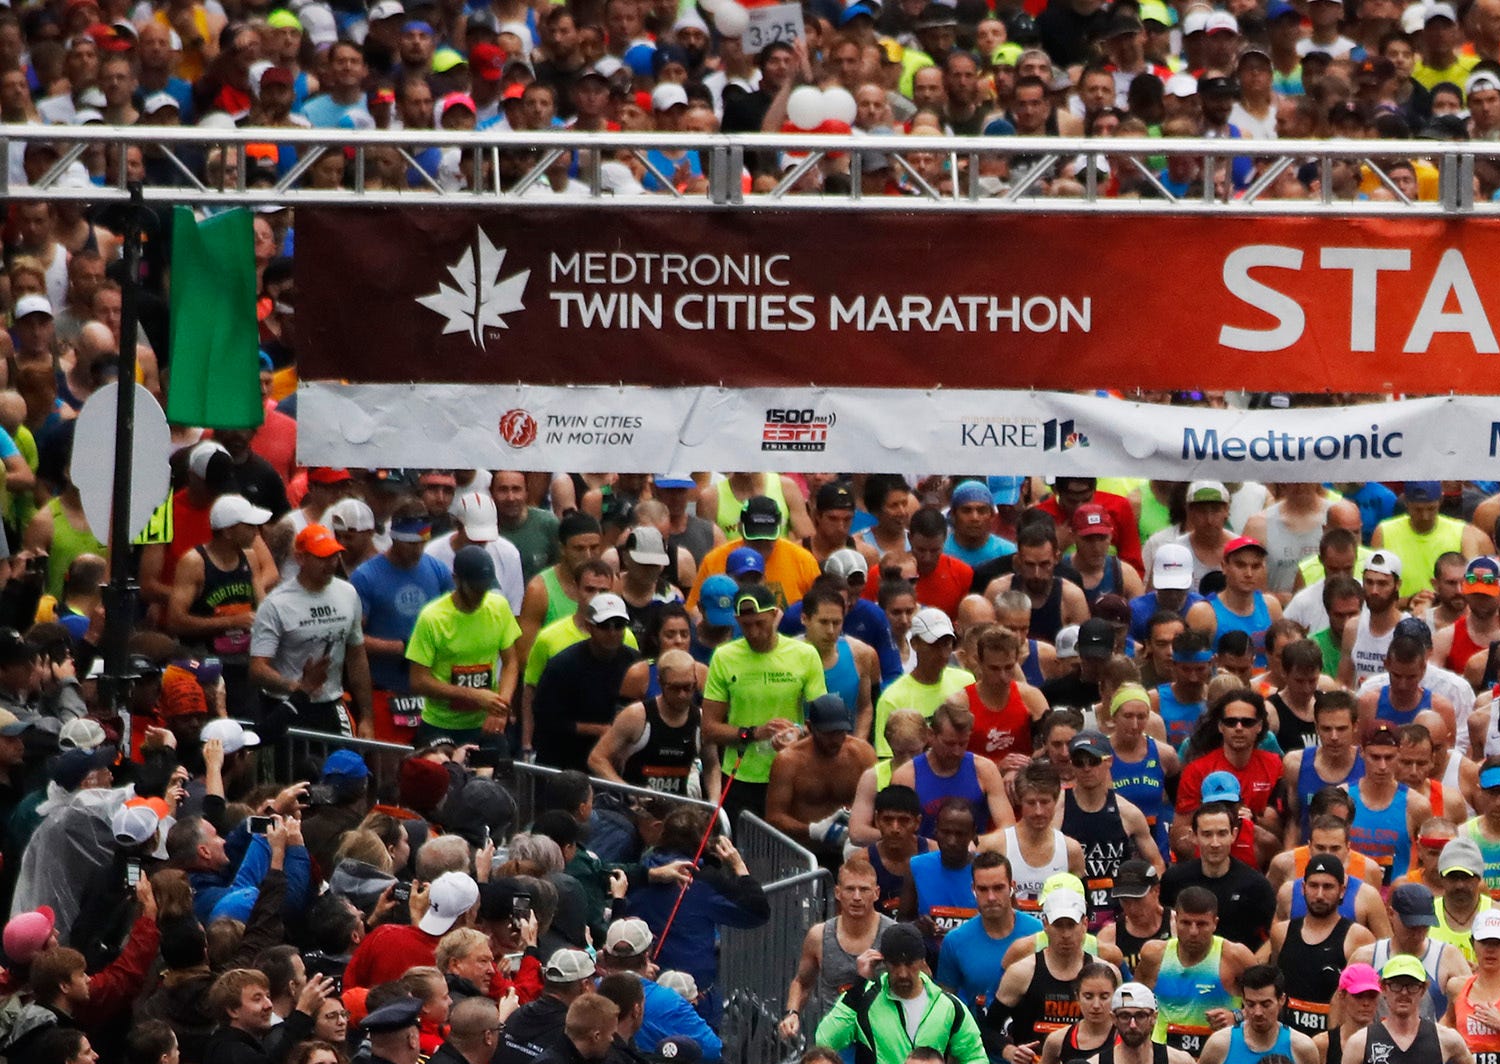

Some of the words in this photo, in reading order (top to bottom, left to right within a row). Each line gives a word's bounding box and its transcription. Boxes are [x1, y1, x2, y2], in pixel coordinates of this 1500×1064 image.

[749, 22, 798, 46] 3:25
[549, 252, 791, 287] MEDTRONIC
[549, 292, 665, 330] TWIN
[673, 293, 817, 332] CITIES
[828, 295, 1093, 334] MARATHON
[546, 415, 588, 429] TWIN
[592, 415, 643, 430] CITIES
[765, 408, 815, 425] 1500
[546, 431, 563, 445] IN
[567, 431, 634, 446] MOTION
[762, 423, 829, 442] ESPN
[960, 423, 1038, 448] KARE
[1042, 418, 1075, 452] 11
[1181, 424, 1404, 463] Medtronic
[206, 582, 253, 605] NORTHS
[310, 605, 337, 619] 300+
[457, 672, 489, 688] 2182
[1142, 776, 1160, 788] Fun
[1293, 1010, 1326, 1030] 1481
[1181, 1034, 1200, 1050] 34
